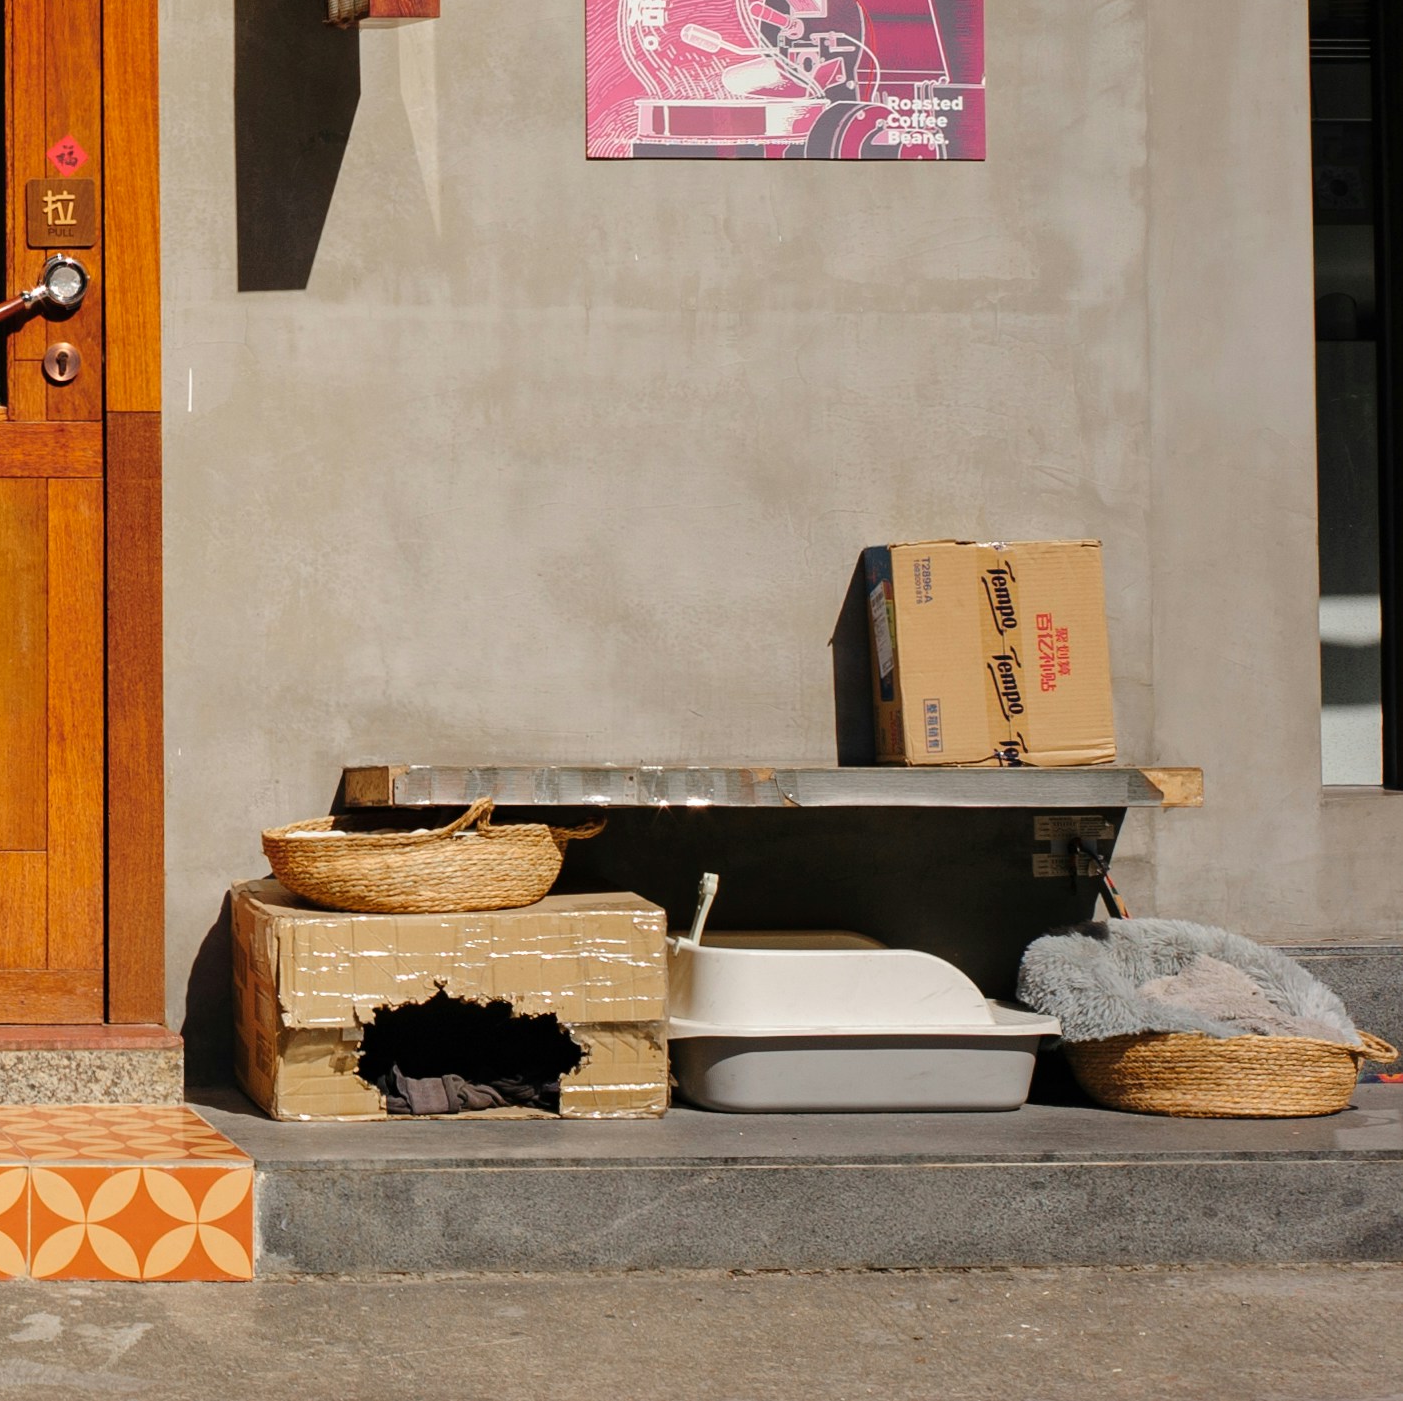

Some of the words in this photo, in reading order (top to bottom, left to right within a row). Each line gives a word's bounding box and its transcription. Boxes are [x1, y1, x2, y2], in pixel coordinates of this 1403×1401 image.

[887, 95, 963, 111] Roasted
[887, 112, 948, 128] Coffee
[888, 131, 949, 145] Beans.
[42, 189, 78, 226] 拉
[47, 227, 75, 238] PULL
[921, 556, 933, 604] T2896-A
[984, 561, 1017, 630] Tempo
[1035, 612, 1057, 693] 百亿补贴
[991, 646, 1025, 716] Tempo
